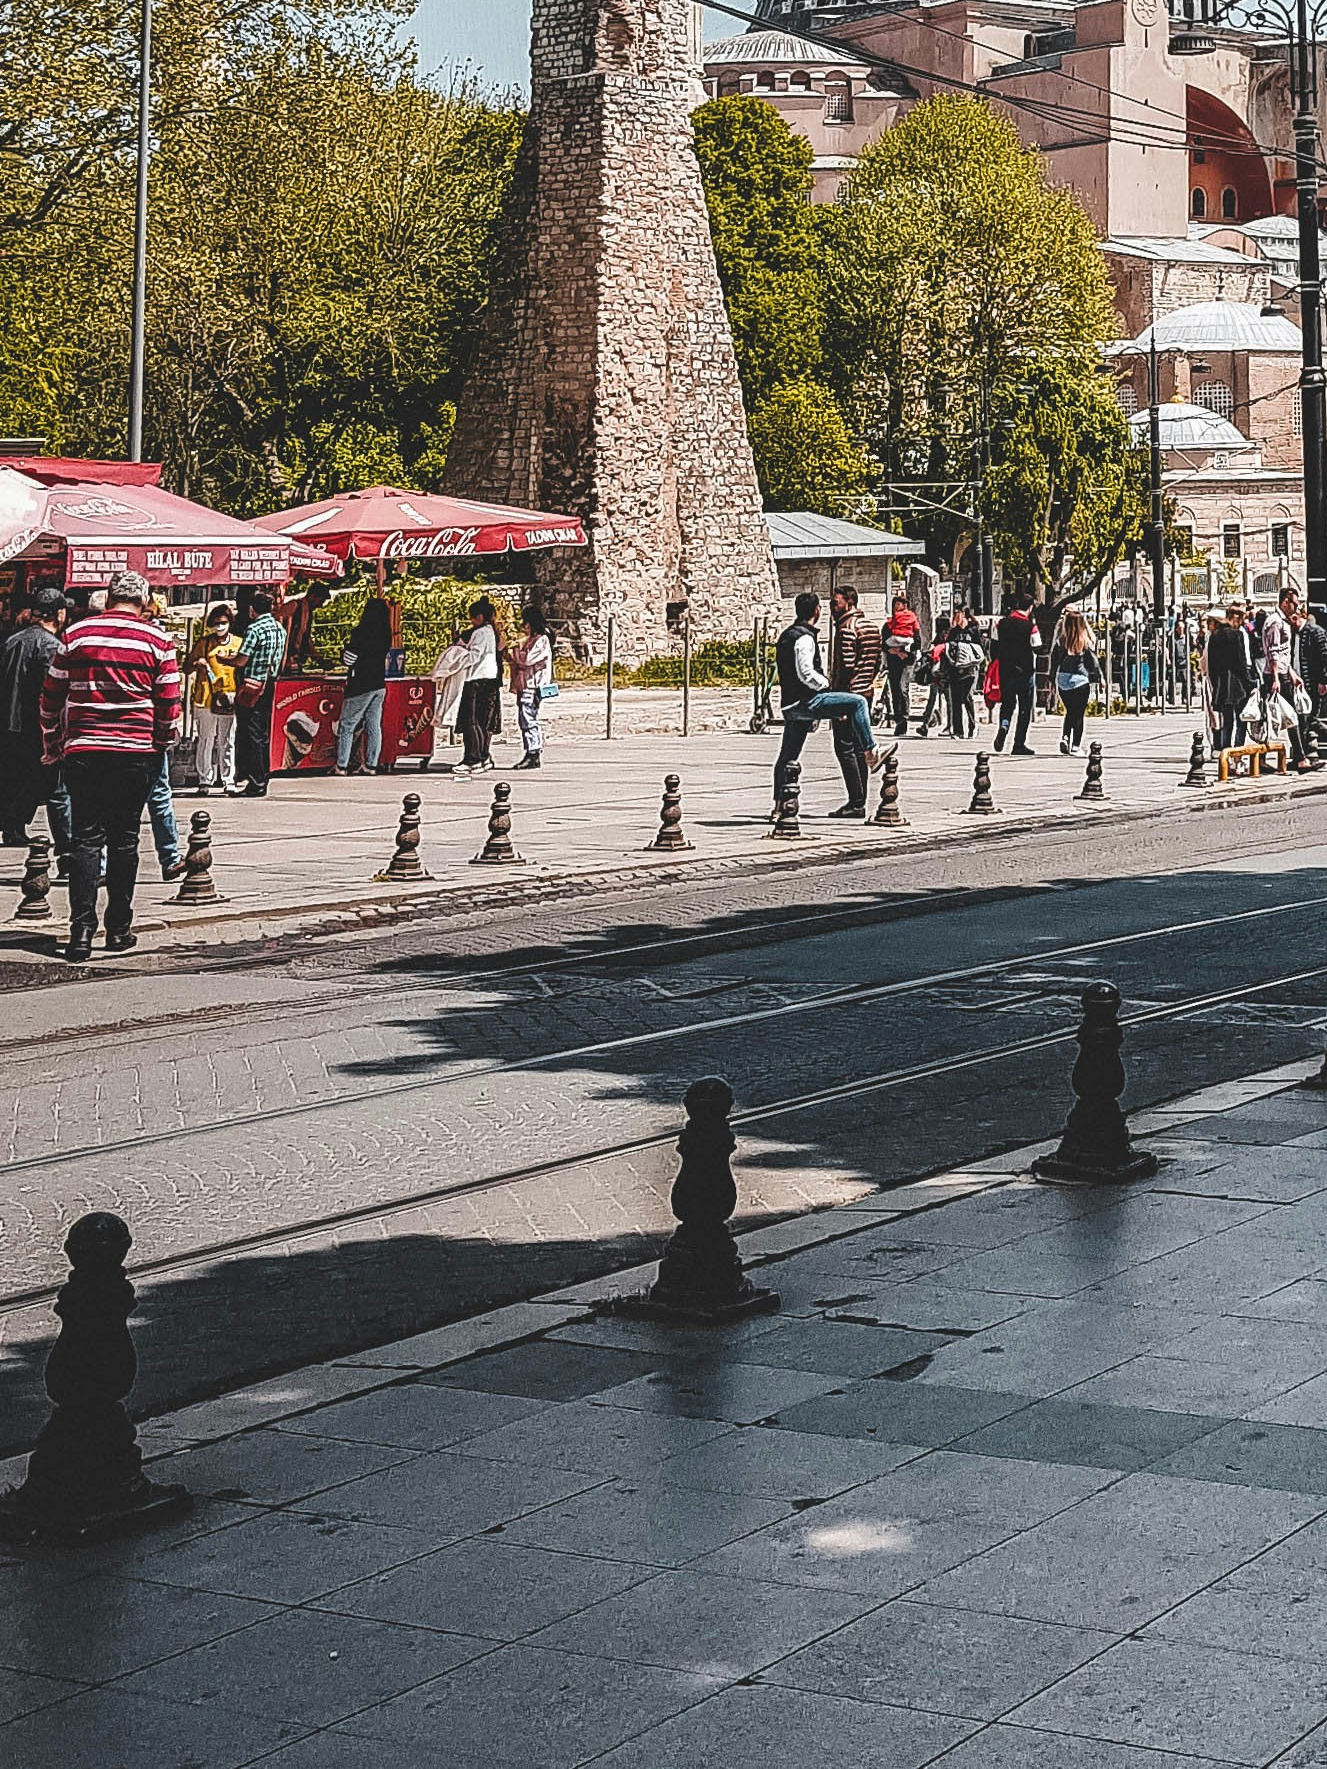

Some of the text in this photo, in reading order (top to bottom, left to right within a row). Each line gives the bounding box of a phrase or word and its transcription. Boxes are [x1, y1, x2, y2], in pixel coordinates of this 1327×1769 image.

[380, 527, 481, 558] Coca-Cola
[147, 550, 181, 568] HİLAL
[184, 548, 213, 568] BÜFE
